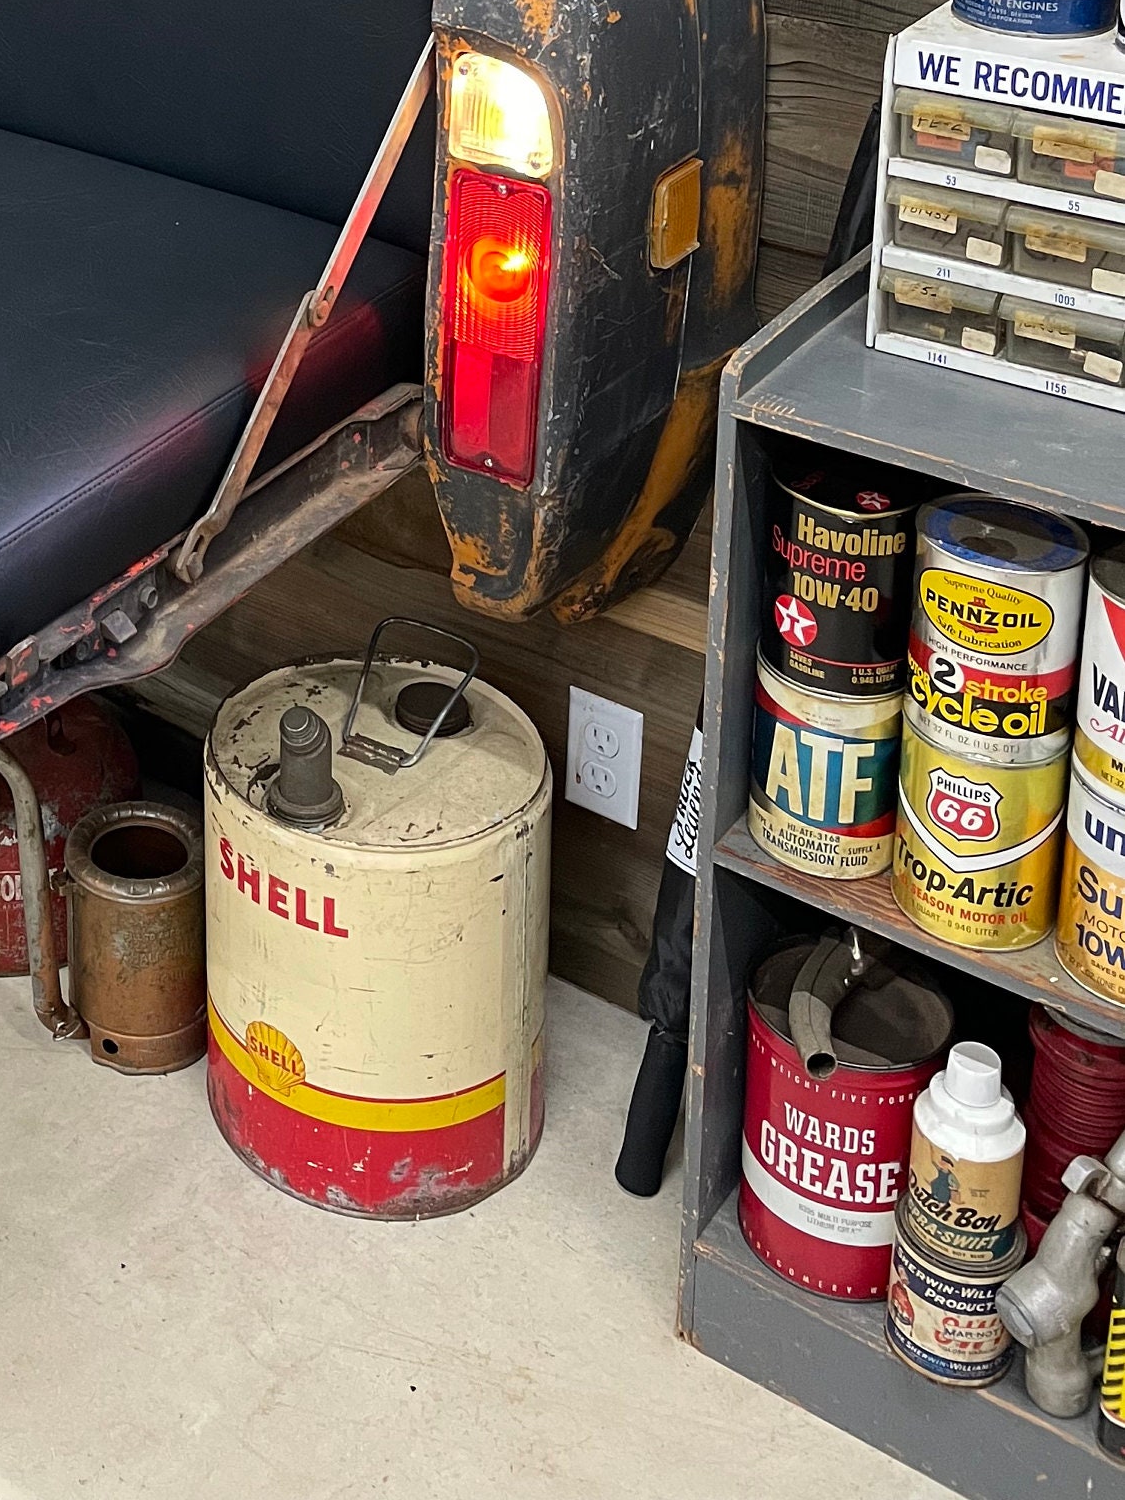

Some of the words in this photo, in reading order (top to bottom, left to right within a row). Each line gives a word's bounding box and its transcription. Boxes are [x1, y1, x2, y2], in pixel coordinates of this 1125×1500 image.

[1006, 0, 1059, 12] ENGINES
[918, 51, 962, 86] WE
[973, 60, 1125, 115] RECOMME
[945, 174, 957, 186] 53
[1068, 200, 1080, 212] 55
[936, 267, 951, 279] 211
[1054, 293, 1076, 307] 1003
[927, 351, 948, 366] 1141
[1045, 380, 1067, 395] 1156
[797, 512, 906, 557] Havoline
[772, 524, 866, 582] Supreme
[925, 587, 1042, 629] PENNZOIL
[943, 575, 985, 594] Supreme
[987, 587, 1023, 606] Quality
[936, 615, 956, 636] Safe
[958, 631, 1022, 650] Lubrication
[789, 650, 813, 666] SAVES
[789, 659, 825, 679] GASOLINE
[928, 636, 948, 653] HIGH
[951, 649, 1028, 671] PERFORMANCE
[933, 657, 956, 689] 2
[964, 678, 1048, 704] stroke
[1002, 699, 1047, 736] oil
[765, 721, 875, 824] ATF
[937, 775, 991, 803] PHILLIPS
[936, 798, 987, 832] 66
[762, 826, 835, 866] TRANSMISSION
[840, 855, 868, 868] FLUID
[778, 828, 840, 855] AUTOMATIC
[220, 837, 349, 939] SHELL
[898, 834, 1034, 908] Trop-Artic
[910, 886, 955, 915] SEASON
[959, 908, 1006, 925] MOTOR
[1011, 911, 1028, 924] OIL
[1077, 865, 1123, 920] Su
[975, 923, 999, 937] LITER
[1090, 959, 1117, 978] SAVES
[250, 1035, 304, 1078] SHELL
[770, 1057, 820, 1093] WEIGHT
[831, 1090, 867, 1105] FIVE
[878, 1090, 921, 1106] POUN
[784, 1101, 875, 1156] WARDS
[760, 1119, 900, 1205] GREASE
[954, 1207, 1002, 1233] Boy
[897, 1246, 995, 1299] SHERWIN-WILL
[924, 1288, 996, 1312] PRODUCT
